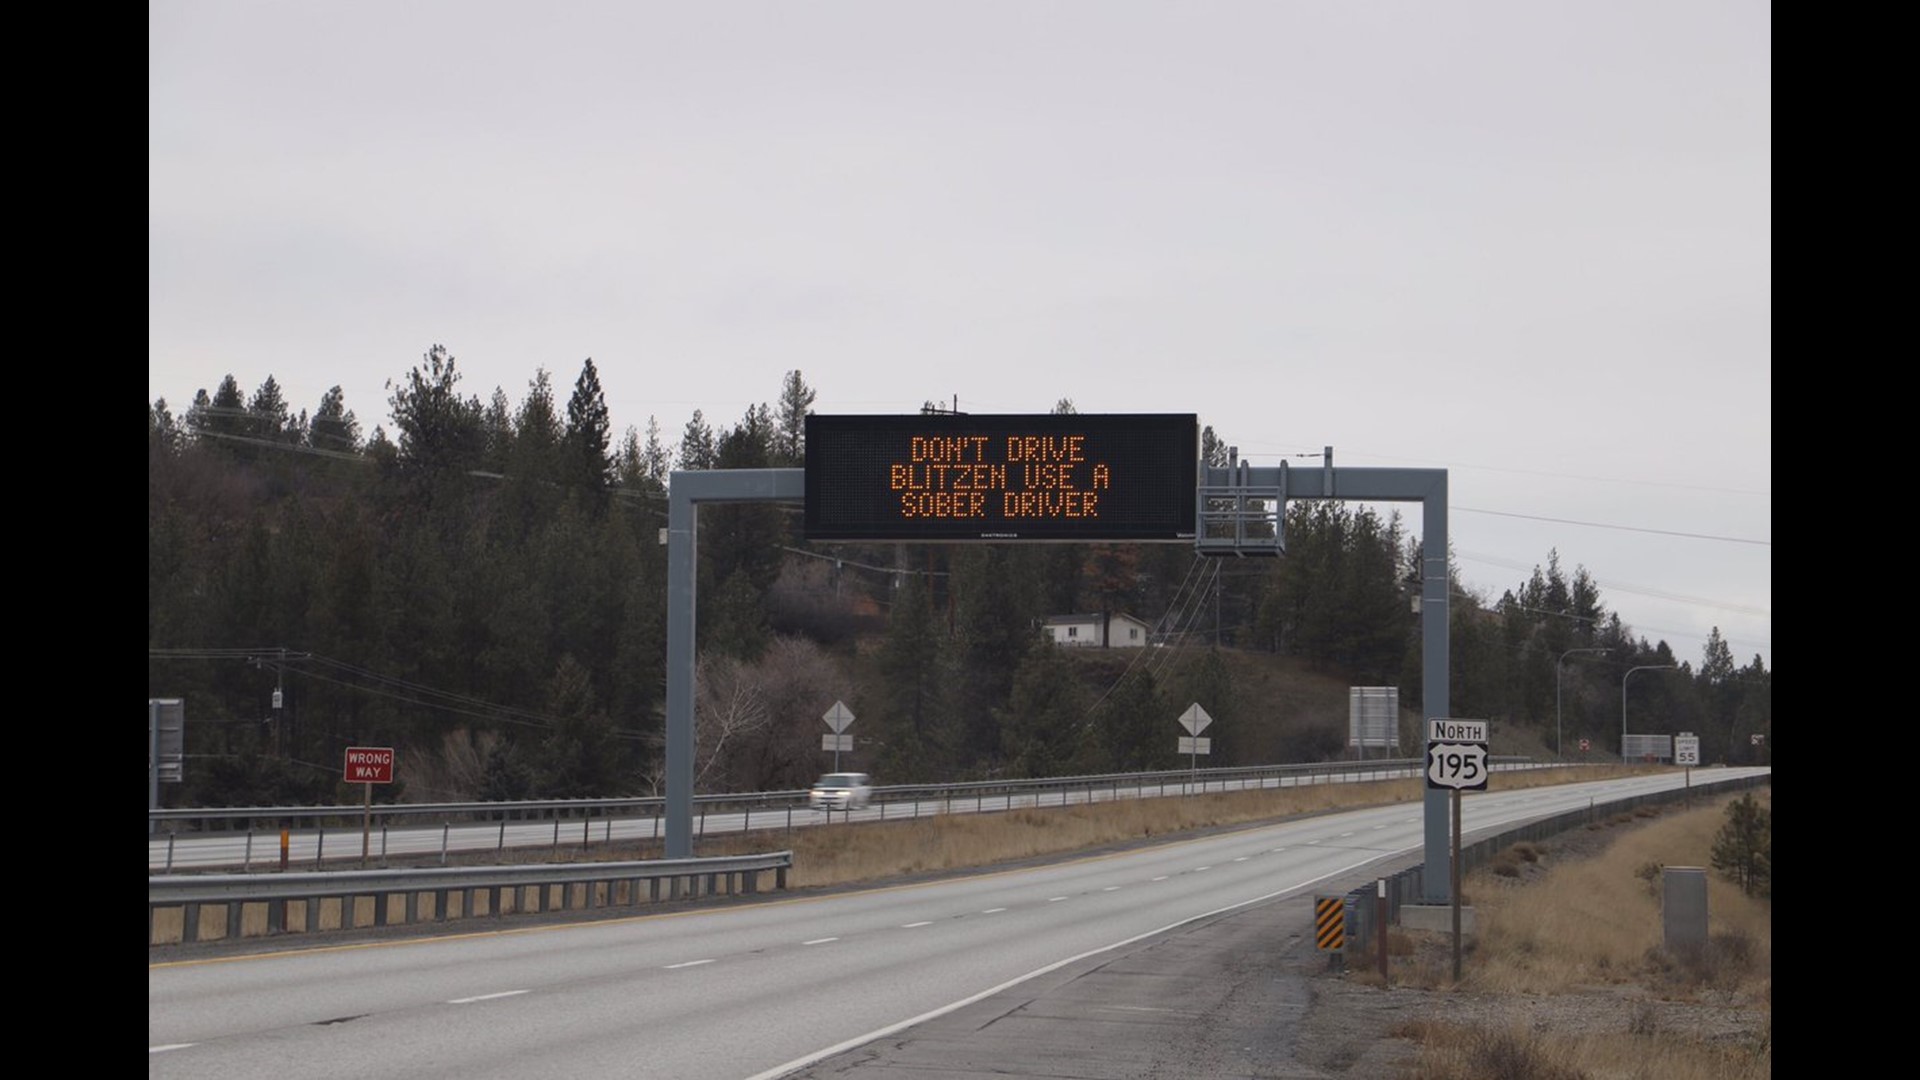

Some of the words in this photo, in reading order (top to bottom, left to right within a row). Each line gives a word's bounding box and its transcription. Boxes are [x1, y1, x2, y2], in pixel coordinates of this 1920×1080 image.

[912, 437, 989, 462] DON'T
[1008, 437, 1084, 462] DRIVE
[891, 464, 1006, 489] BLITZEN
[1025, 464, 1074, 489] USE
[1093, 464, 1109, 489] A
[902, 492, 985, 517] SOBER
[1004, 492, 1098, 517] DRIVER
[349, 753, 390, 764] WRONG
[1437, 753, 1478, 779] 195
[1679, 752, 1696, 762] 55
[356, 767, 381, 778] WAY
